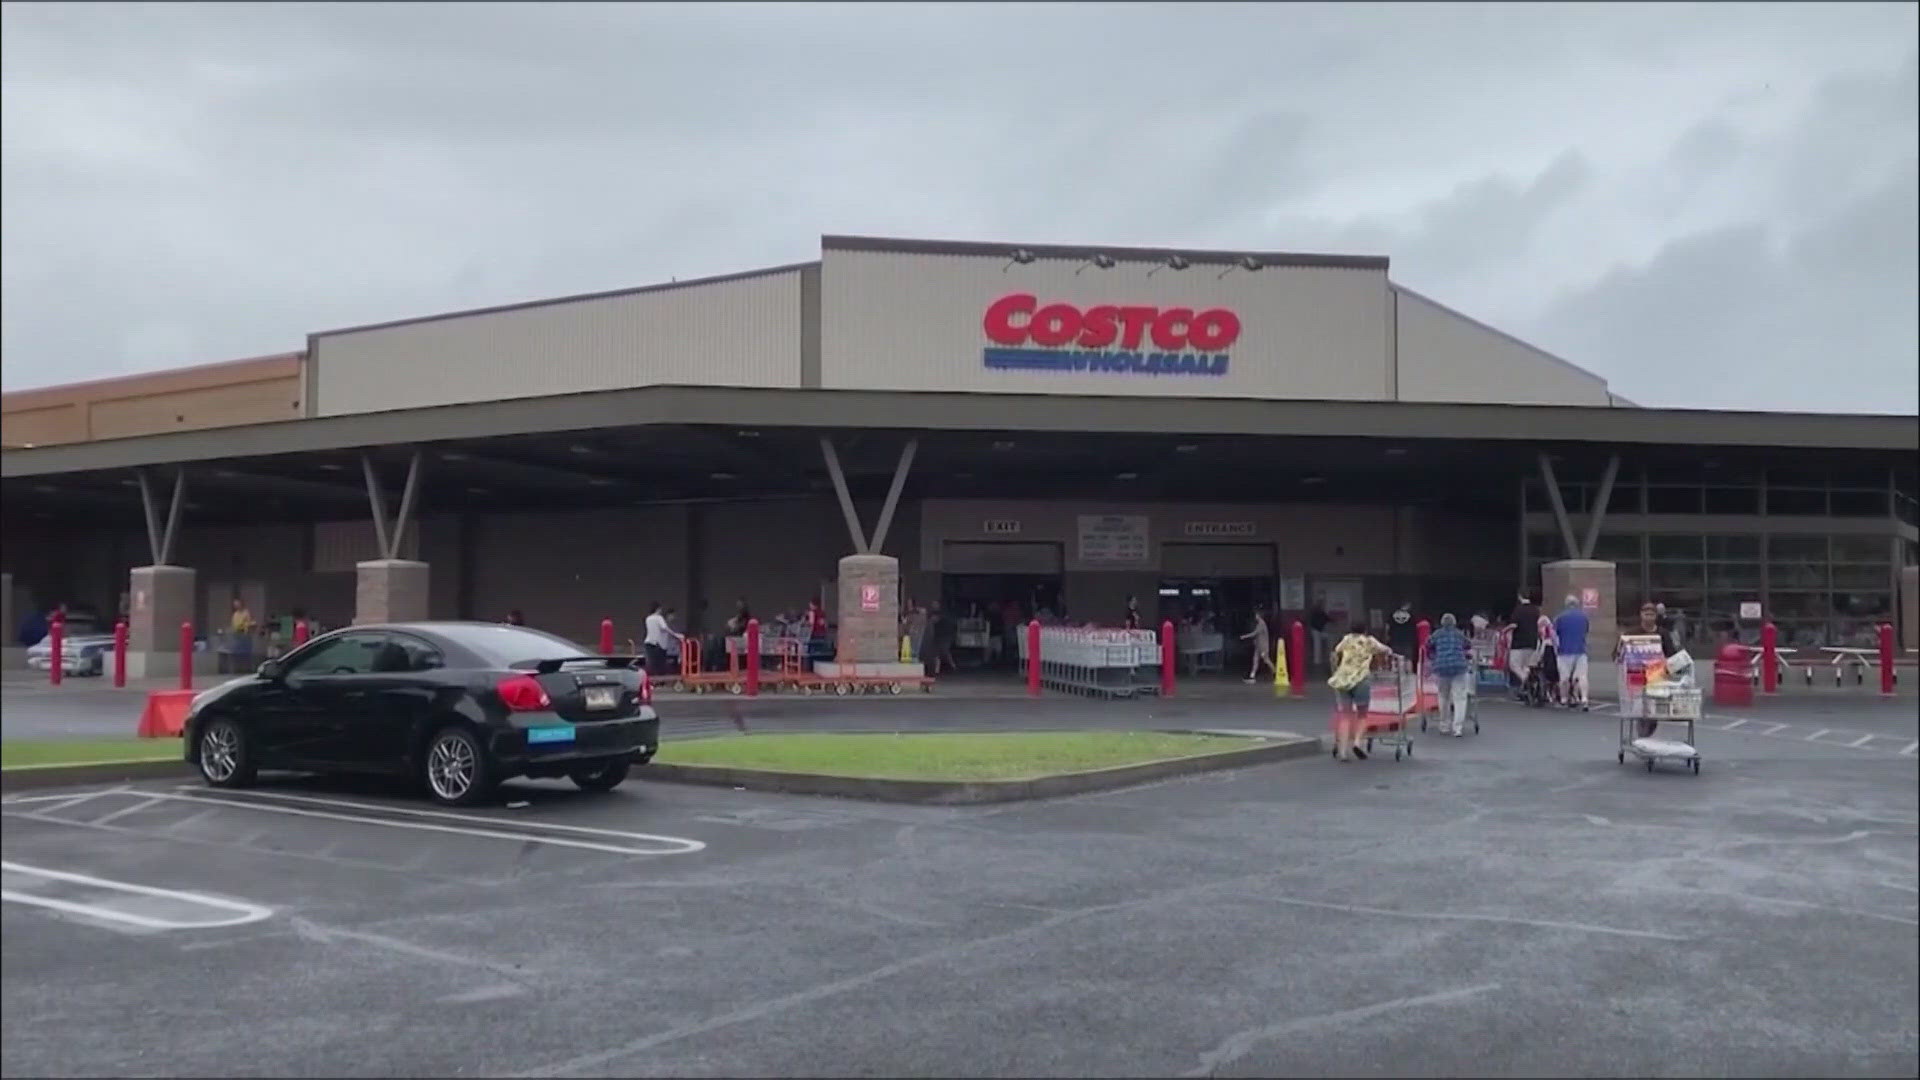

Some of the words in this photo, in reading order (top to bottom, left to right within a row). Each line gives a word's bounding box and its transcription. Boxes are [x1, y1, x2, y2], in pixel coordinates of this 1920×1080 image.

[984, 294, 1240, 350] COSTCO
[1068, 351, 1229, 375] WHOLESALE
[986, 521, 1018, 532] EXIT
[1187, 523, 1254, 534] ENTRANCE
